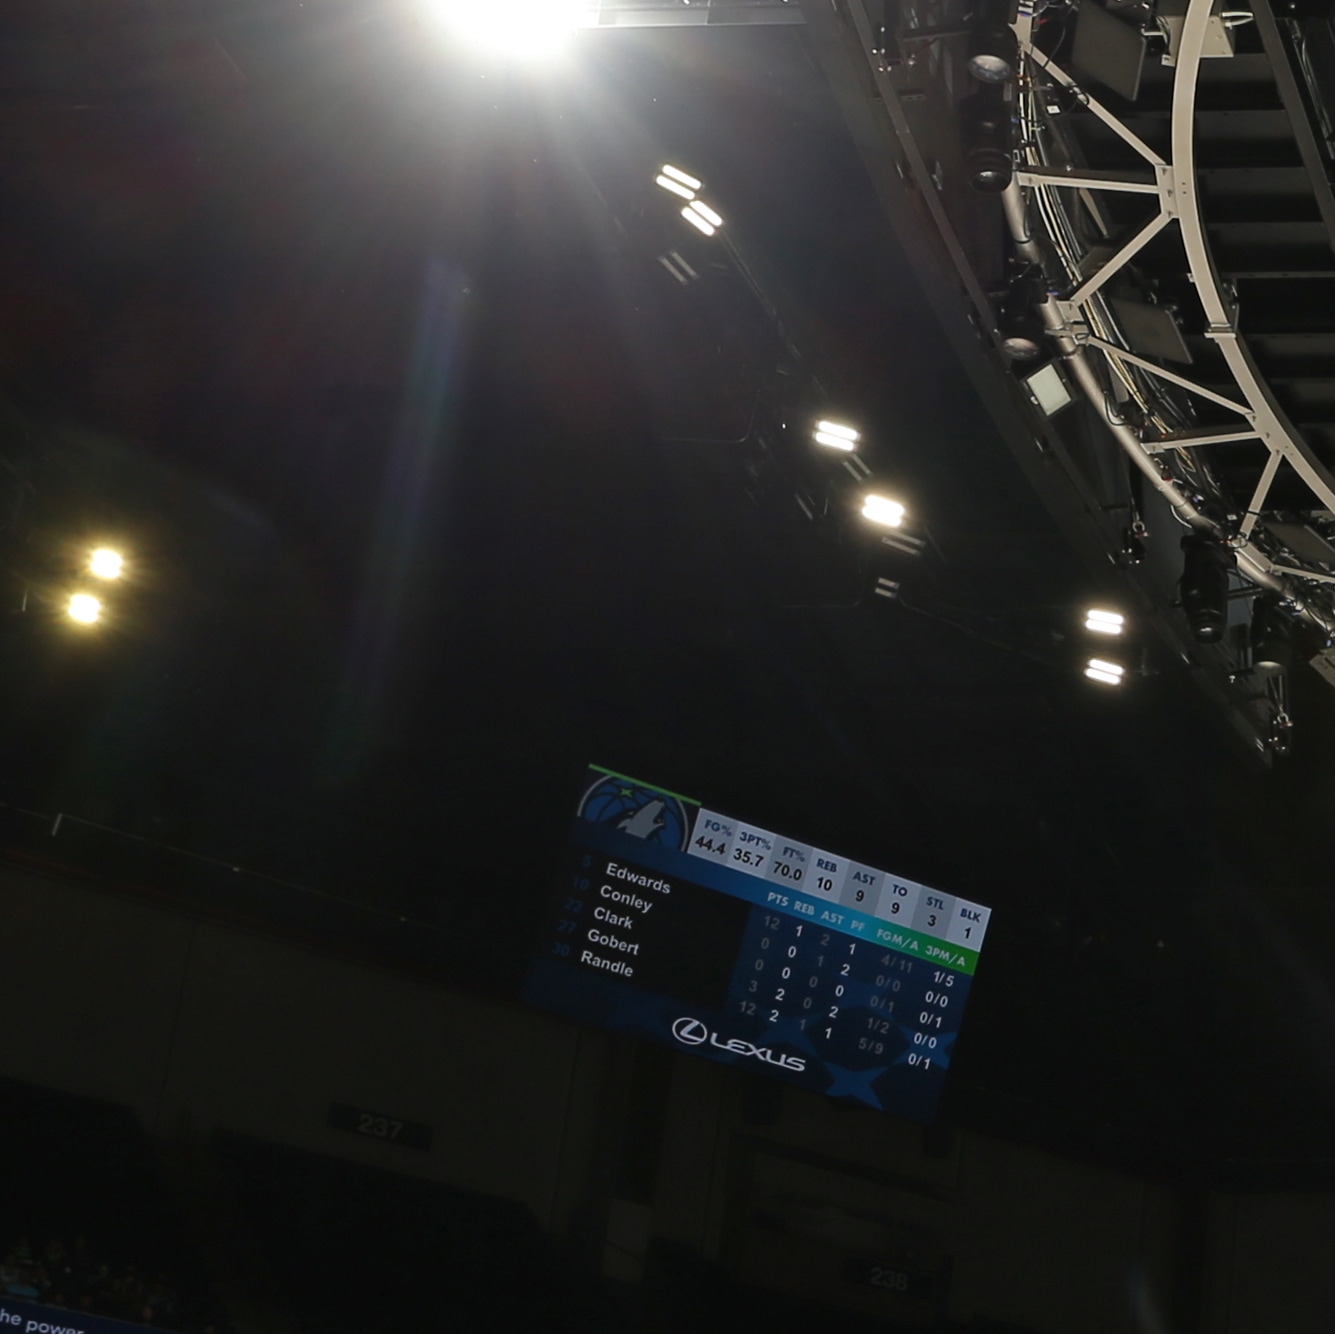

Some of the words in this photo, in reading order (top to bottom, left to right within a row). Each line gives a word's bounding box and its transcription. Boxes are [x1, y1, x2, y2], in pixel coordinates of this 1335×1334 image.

[606, 863, 671, 894] Edwards
[933, 971, 954, 987] 1/5
[695, 836, 725, 856] 44.4
[733, 848, 763, 867] 35.7
[774, 861, 802, 881] 70.0
[816, 877, 832, 891] 10
[856, 890, 865, 902] 9
[891, 902, 900, 914] 9
[928, 915, 936, 927] 3
[964, 927, 971, 939] 1
[704, 820, 732, 836] FG%
[740, 831, 771, 850] 3PT%
[782, 846, 805, 861] FT%
[817, 858, 837, 872] REB
[853, 871, 875, 886] AST
[892, 884, 908, 897] TO
[926, 897, 944, 910] STL
[960, 908, 981, 922] BLK
[594, 907, 632, 929] Clark
[920, 1012, 941, 1028] 0/1
[600, 886, 652, 914] Conley
[925, 991, 948, 1007] 0/0
[768, 892, 788, 907] PTS
[794, 902, 815, 915] REB
[821, 910, 844, 925] AST
[851, 920, 865, 932] PF
[877, 928, 918, 950] FGM/A
[925, 945, 965, 967] 3PM/A
[581, 950, 633, 977] Randle
[908, 1053, 930, 1069] 0/1
[588, 929, 639, 955] Gobert
[914, 1032, 936, 1049] 0/0
[711, 1032, 806, 1071] LEXUS
[0, 1308, 22, 1325] he
